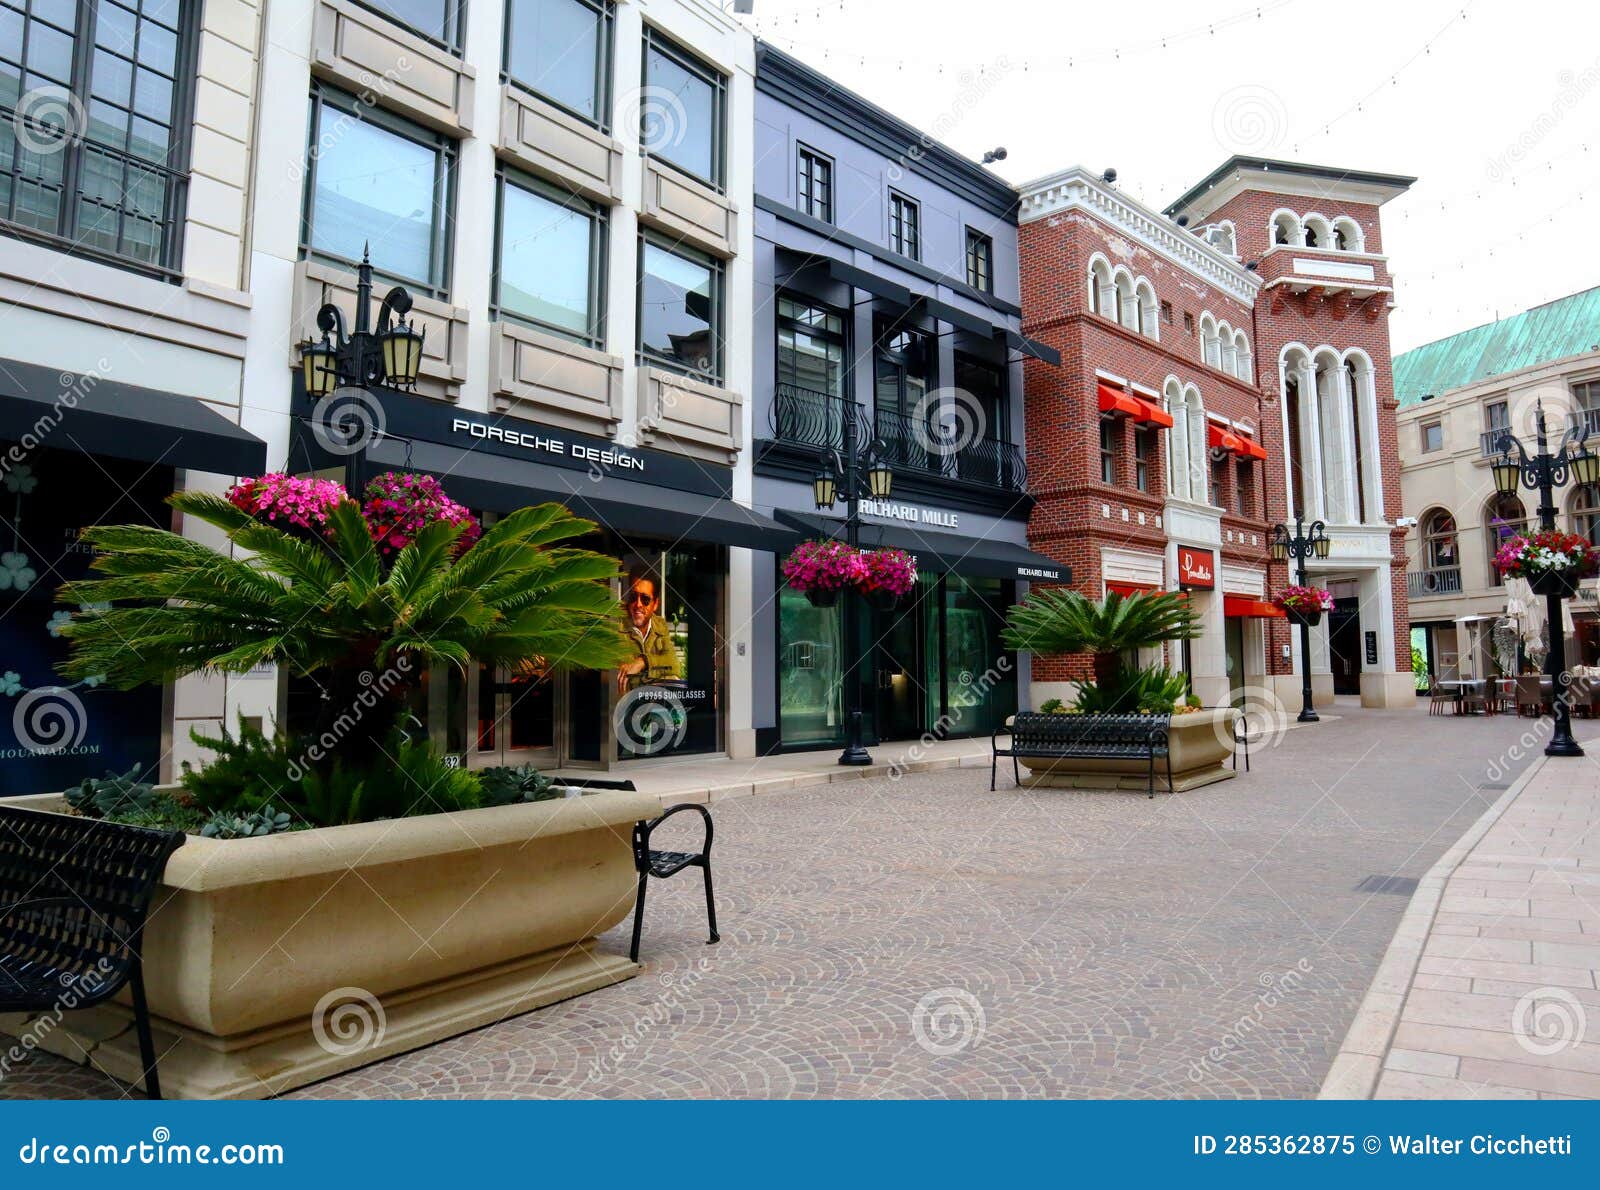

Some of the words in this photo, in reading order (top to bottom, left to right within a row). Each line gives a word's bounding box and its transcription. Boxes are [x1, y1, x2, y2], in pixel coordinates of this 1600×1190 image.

[453, 419, 564, 454] PORSCHE
[572, 444, 644, 471] DESIGN
[859, 499, 918, 521] RICHARD
[921, 509, 958, 528] MILLE
[1017, 567, 1043, 577] RICHARD
[1042, 570, 1059, 579] MILLE
[663, 690, 706, 700] SUNGLASSES
